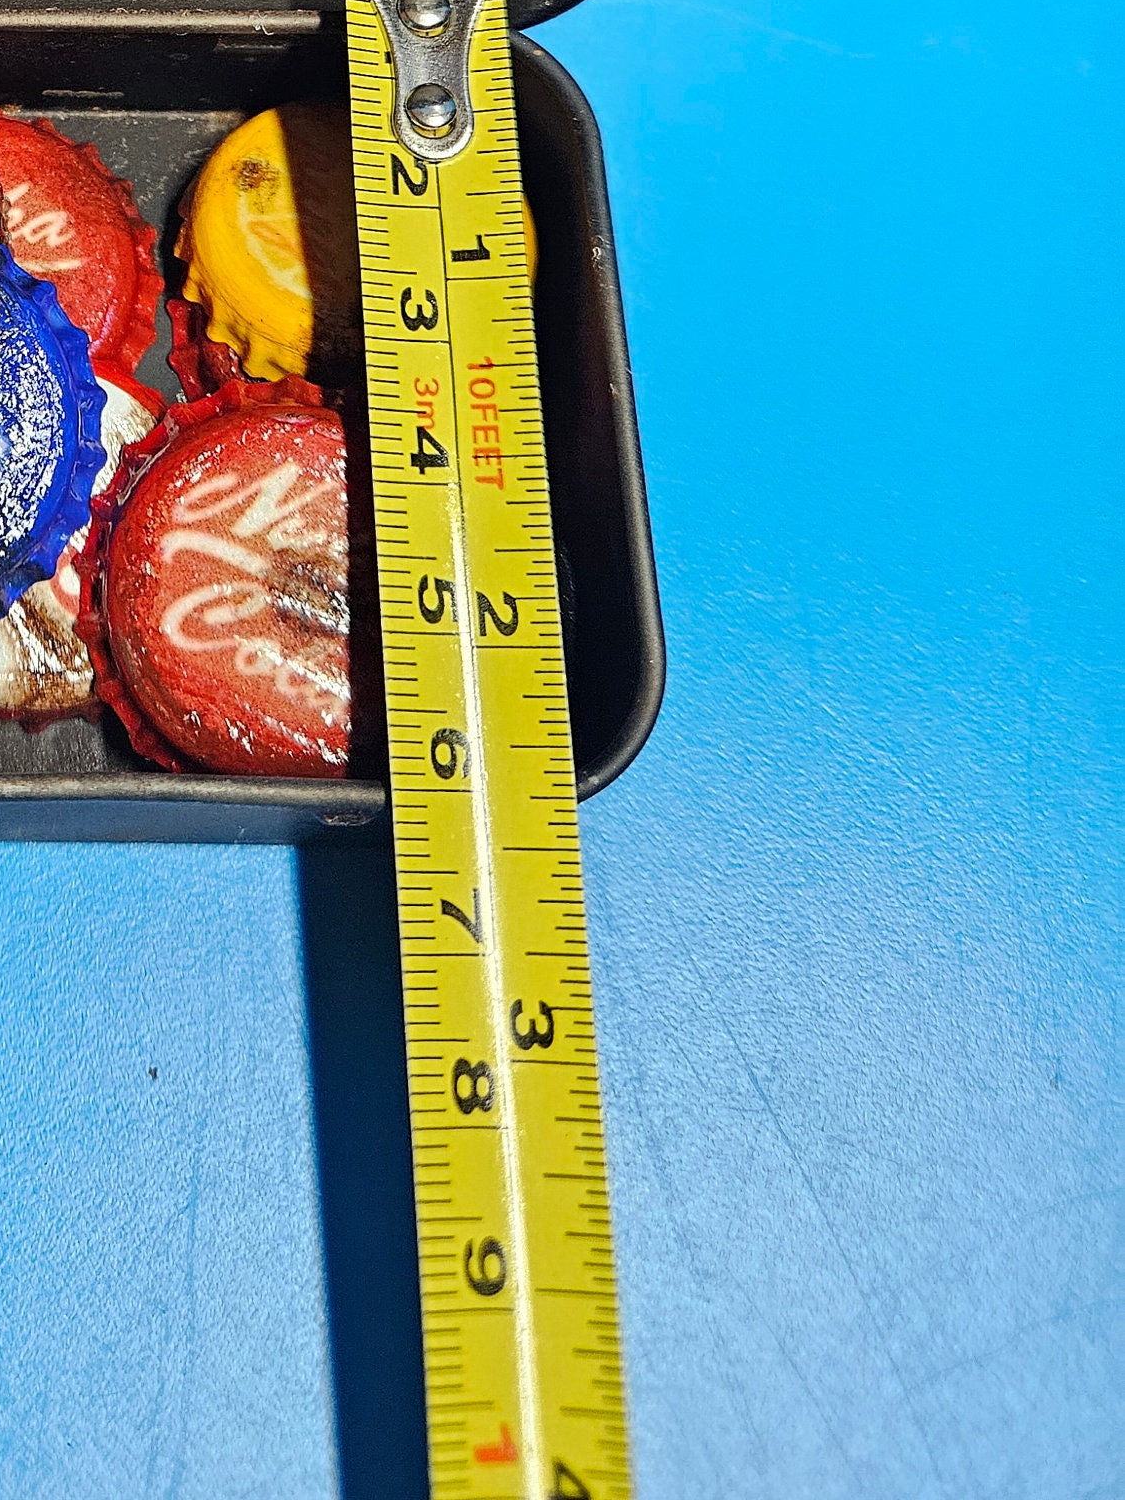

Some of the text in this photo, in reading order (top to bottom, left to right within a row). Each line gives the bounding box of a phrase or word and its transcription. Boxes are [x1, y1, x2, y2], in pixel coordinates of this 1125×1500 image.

[390, 153, 429, 197] 2
[450, 234, 491, 264] 1
[400, 287, 439, 332] 3
[414, 377, 440, 431] 3m
[410, 426, 450, 475] 4
[417, 573, 458, 624] 5
[475, 590, 520, 637] 2
[430, 727, 473, 781] 6
[440, 887, 483, 944] 7
[510, 999, 556, 1052] 3
[452, 1057, 496, 1116] 8
[462, 1234, 508, 1298] 9
